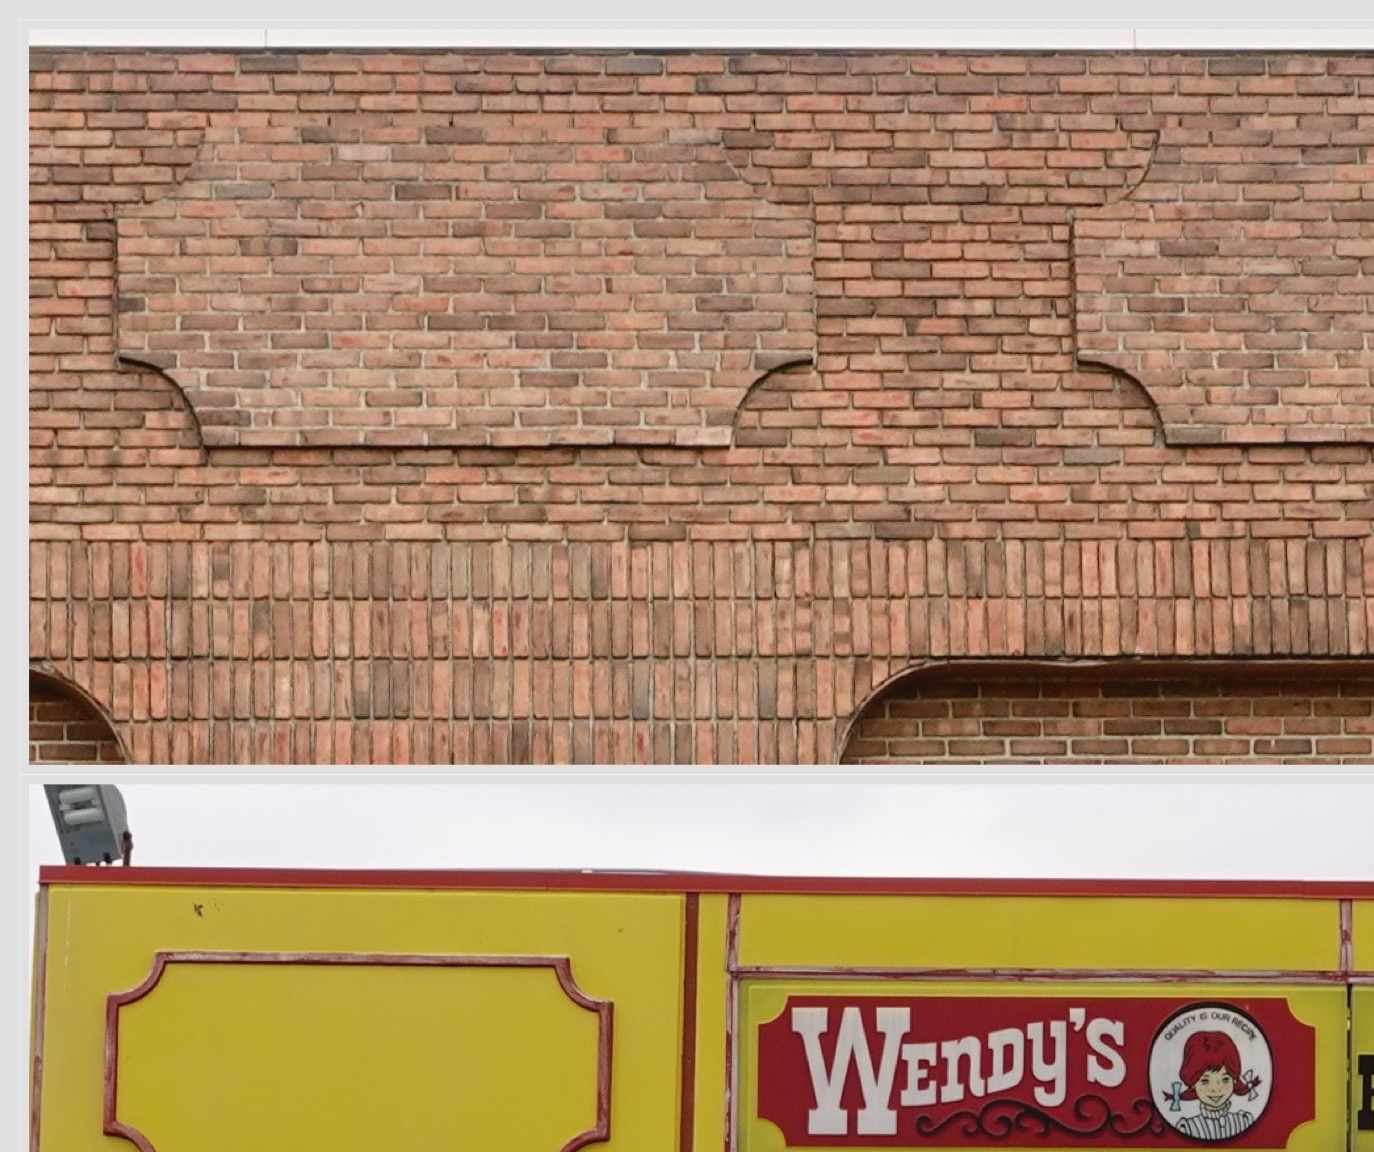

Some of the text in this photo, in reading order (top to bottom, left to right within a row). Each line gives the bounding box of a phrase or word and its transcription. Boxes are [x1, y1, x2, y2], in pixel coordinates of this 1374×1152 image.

[1164, 1014, 1196, 1041] QUALITY
[1199, 1011, 1208, 1020] IS
[1210, 1011, 1231, 1022] OUR
